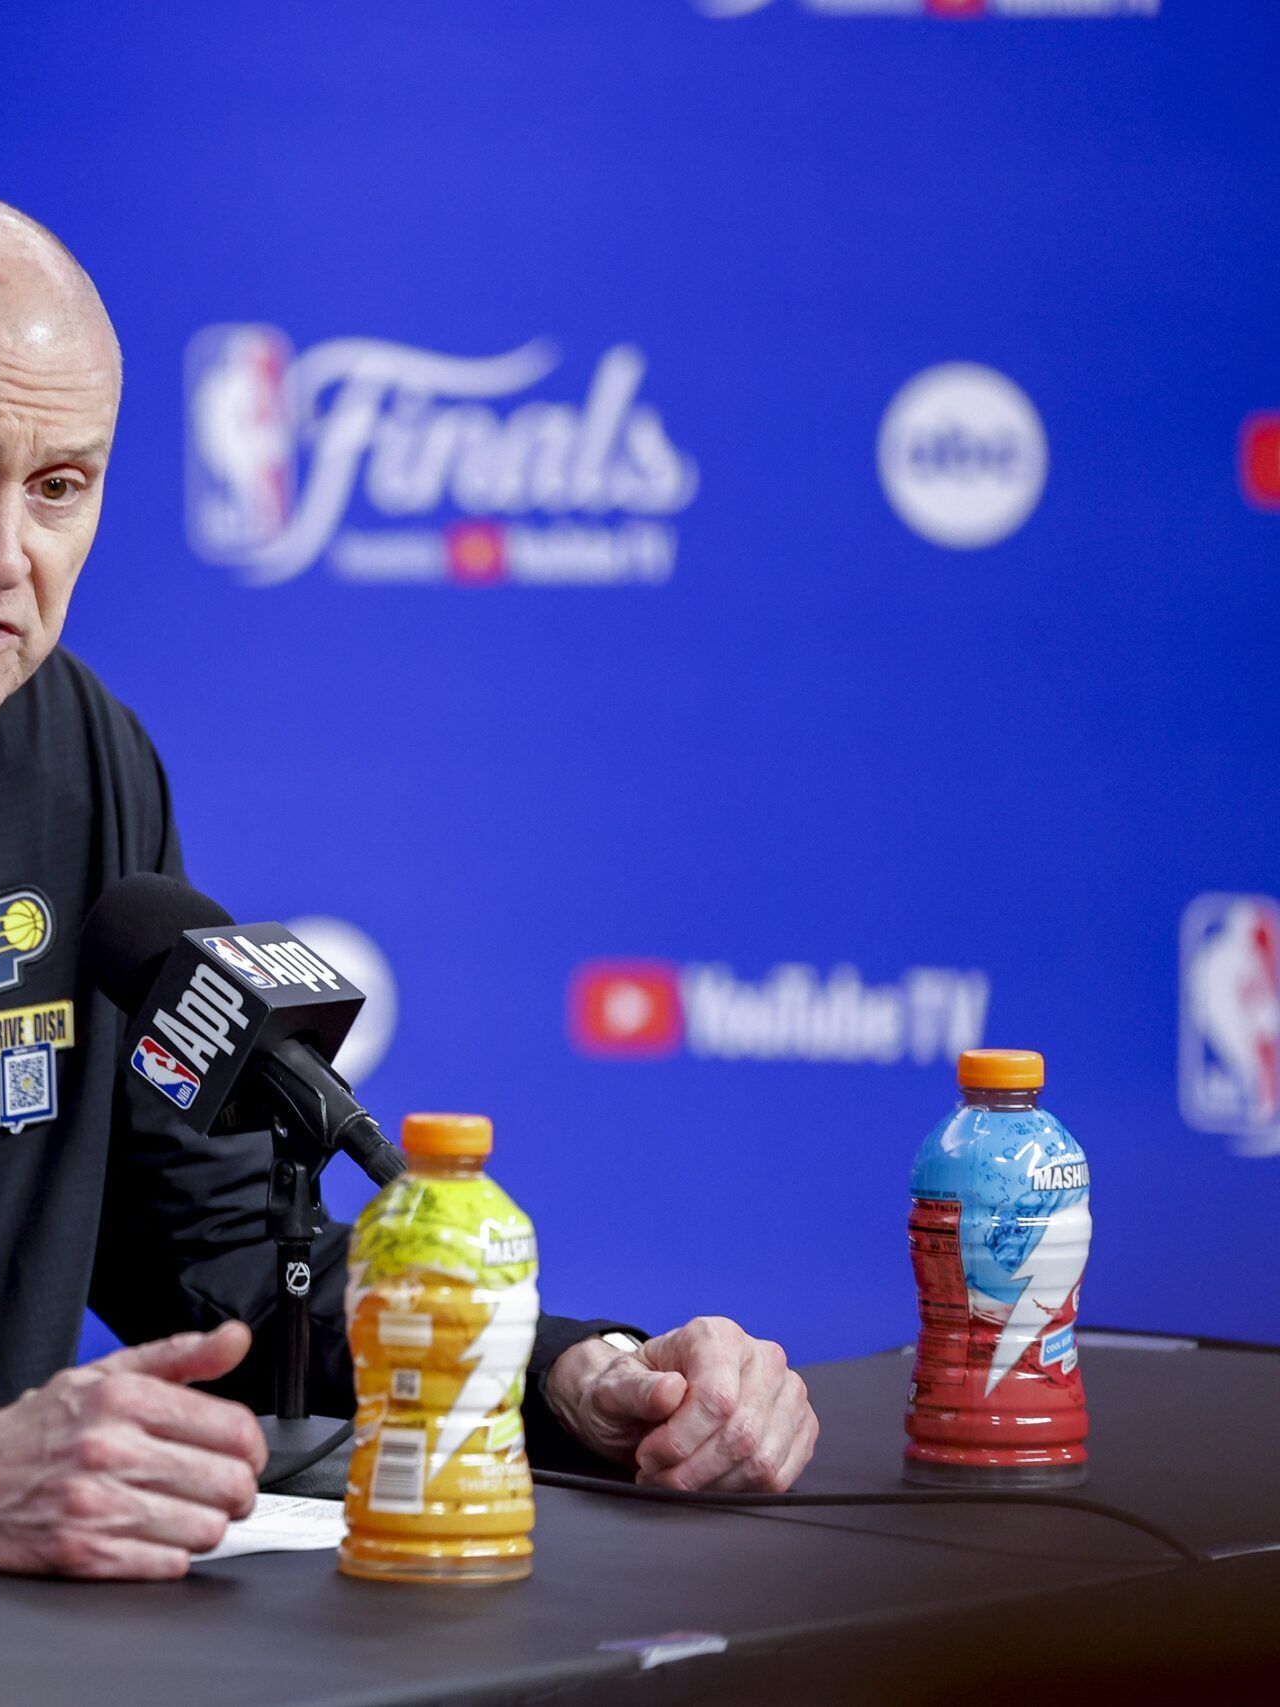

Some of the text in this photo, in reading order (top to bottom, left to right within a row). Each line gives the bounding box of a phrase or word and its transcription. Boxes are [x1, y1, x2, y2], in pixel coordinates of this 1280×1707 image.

[240, 336, 699, 587] Finals
[233, 935, 341, 993] App
[34, 1009, 66, 1042] DISH
[152, 963, 250, 1075] App
[176, 1083, 193, 1105] NBA
